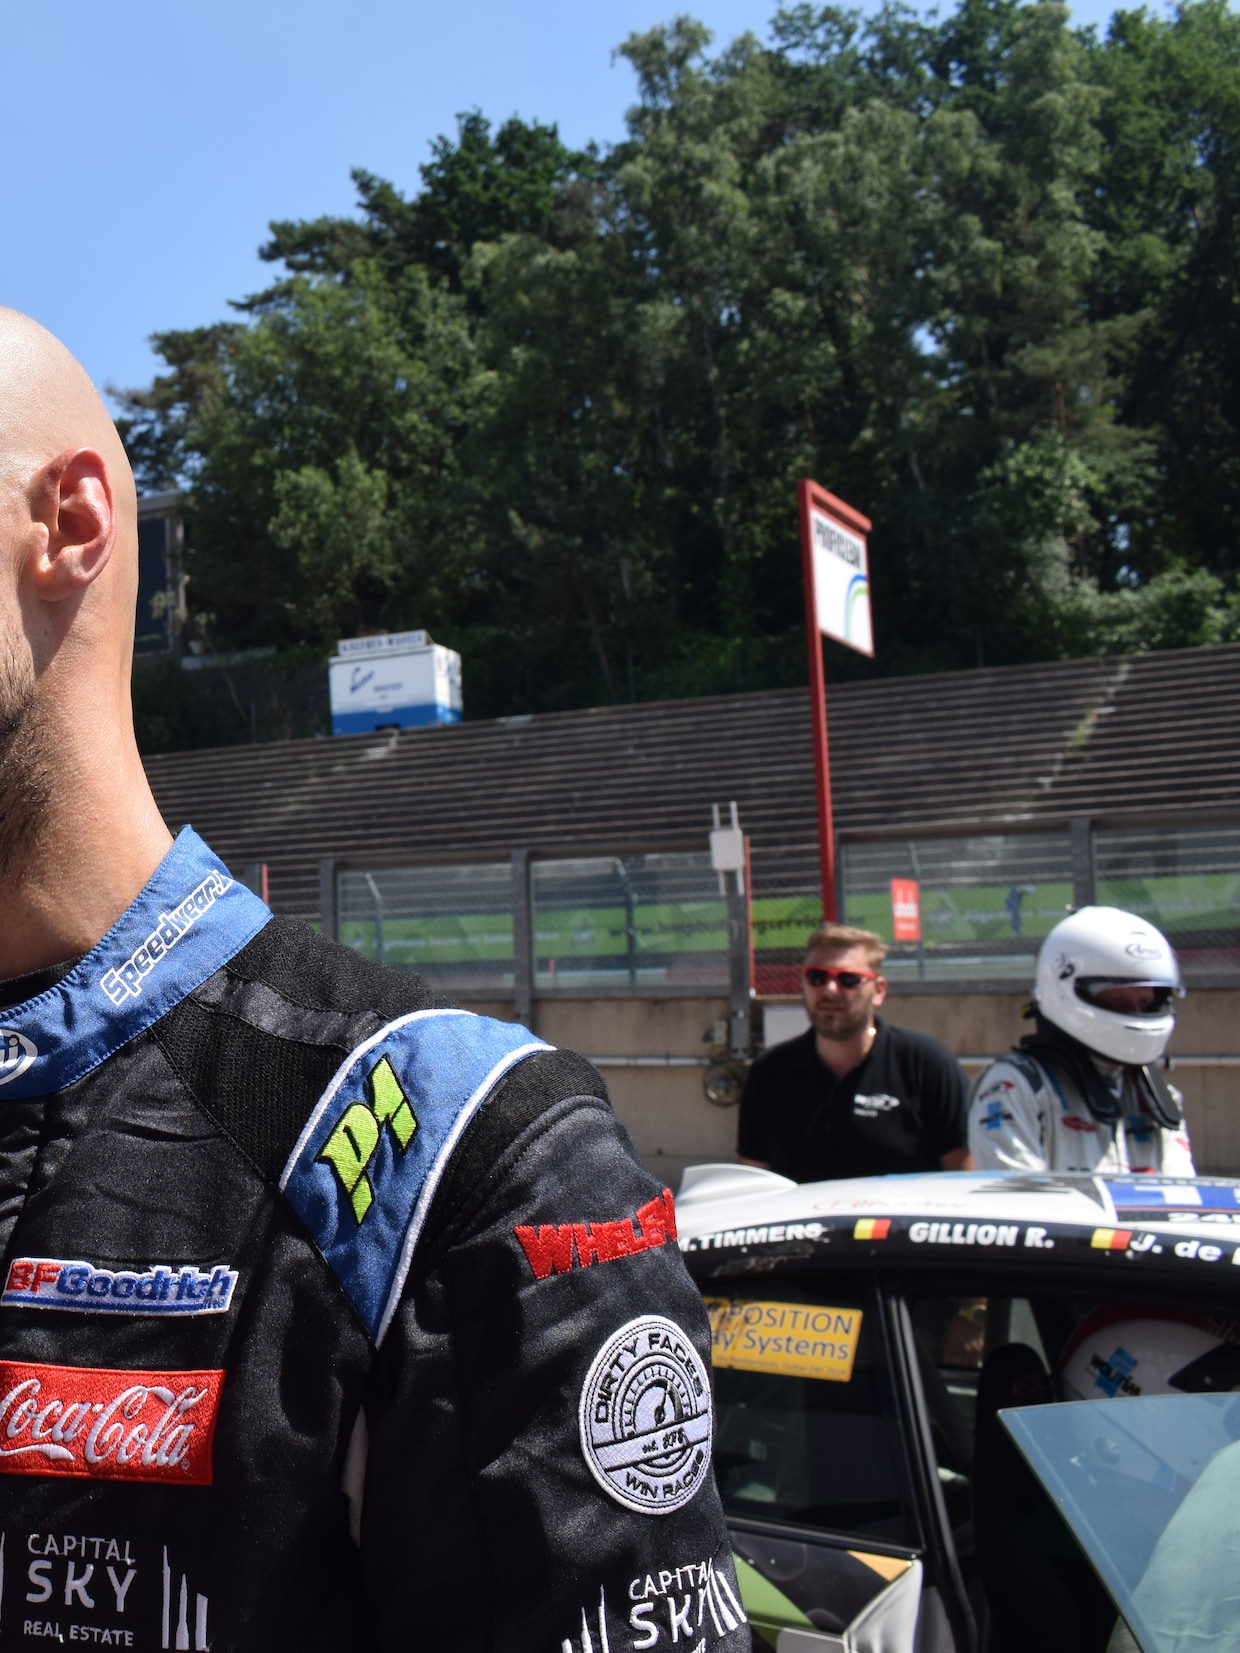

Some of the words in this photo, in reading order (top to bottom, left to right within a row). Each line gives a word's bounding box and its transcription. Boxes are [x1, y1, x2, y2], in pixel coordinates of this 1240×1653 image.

[513, 1187, 678, 1281] WHELEN
[908, 1222, 1019, 1248] GILLION
[1024, 1227, 1056, 1249] R.
[1174, 1240, 1223, 1262] de
[729, 1304, 854, 1336] POSITION
[742, 1329, 850, 1361] Systems
[594, 1337, 639, 1424] DIRTY
[648, 1333, 704, 1398] FACES
[626, 1471, 659, 1499] WIN
[27, 1533, 137, 1565] CAPITAL
[26, 1559, 138, 1613] SKY
[23, 1619, 63, 1638] REAL
[69, 1624, 134, 1646] ESTATE
